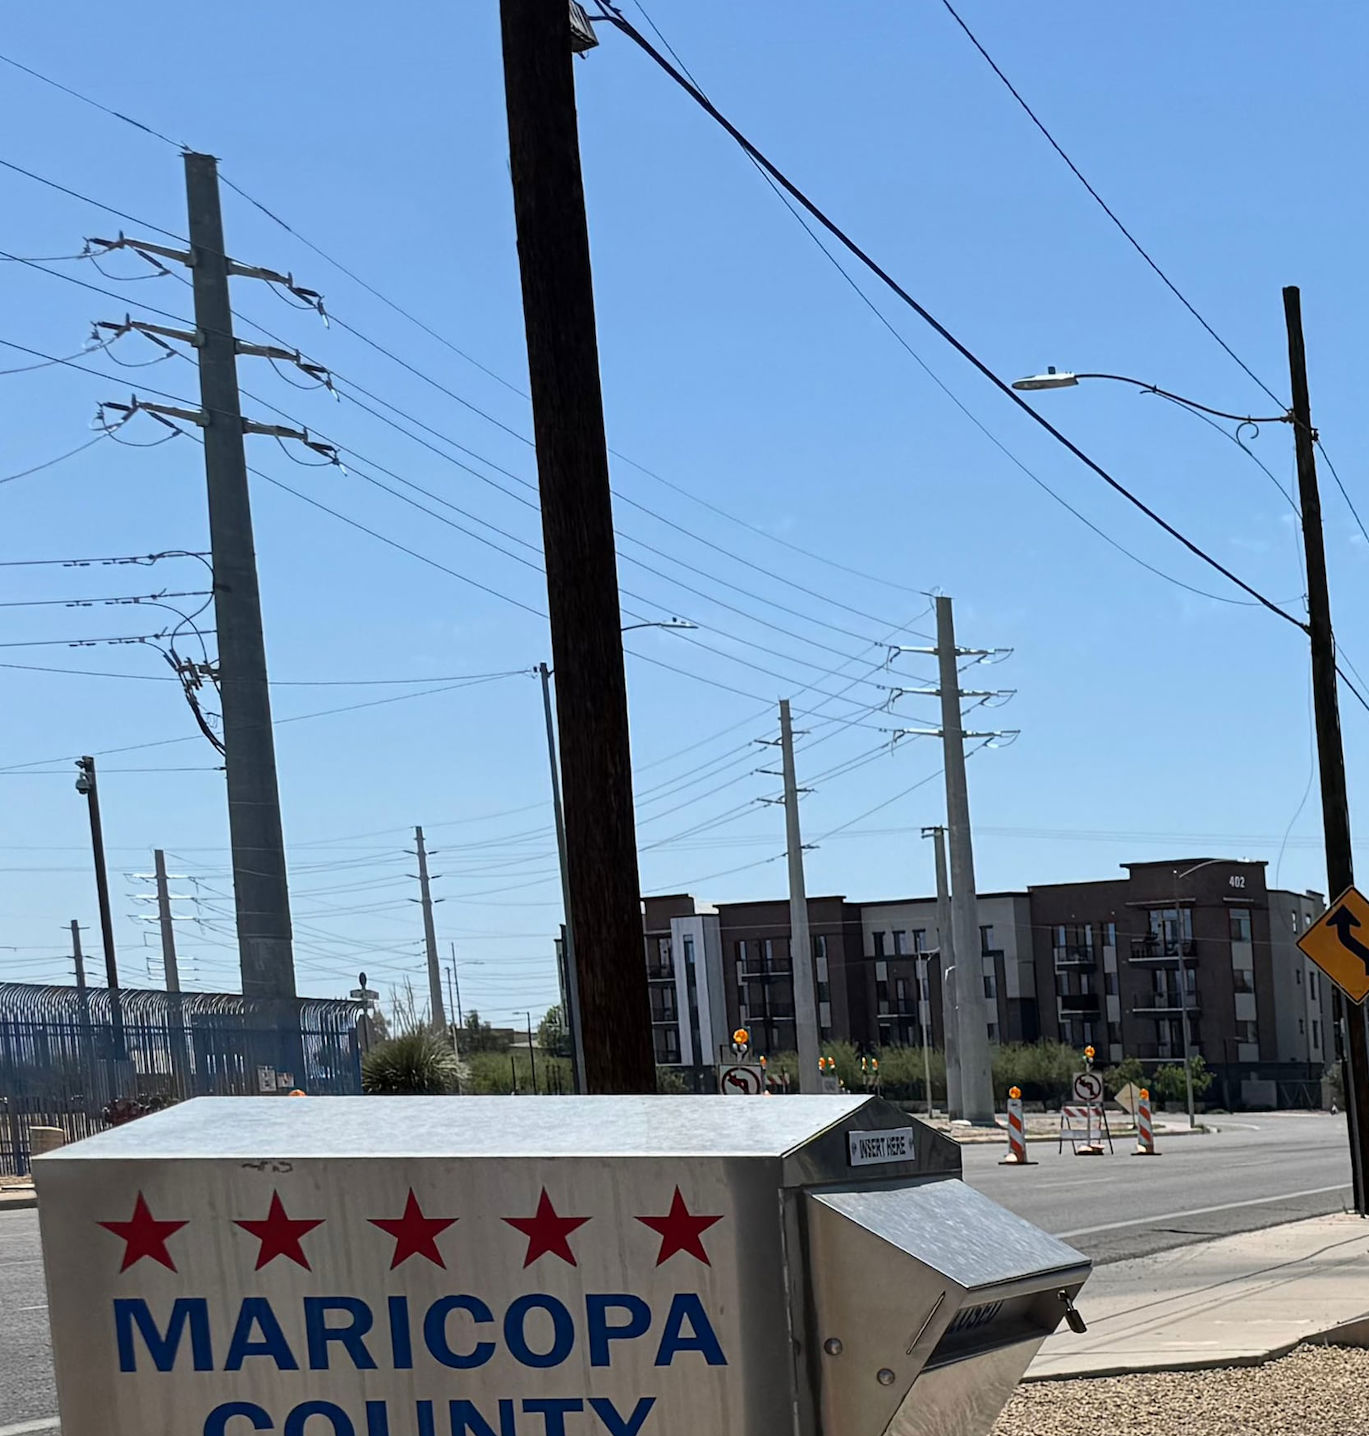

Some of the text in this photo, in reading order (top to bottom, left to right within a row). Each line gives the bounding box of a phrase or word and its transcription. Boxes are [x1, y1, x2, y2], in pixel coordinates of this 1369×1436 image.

[1229, 876, 1246, 888] 402
[860, 1136, 906, 1159] INSERT HERE
[114, 1293, 727, 1372] MARICOPA
